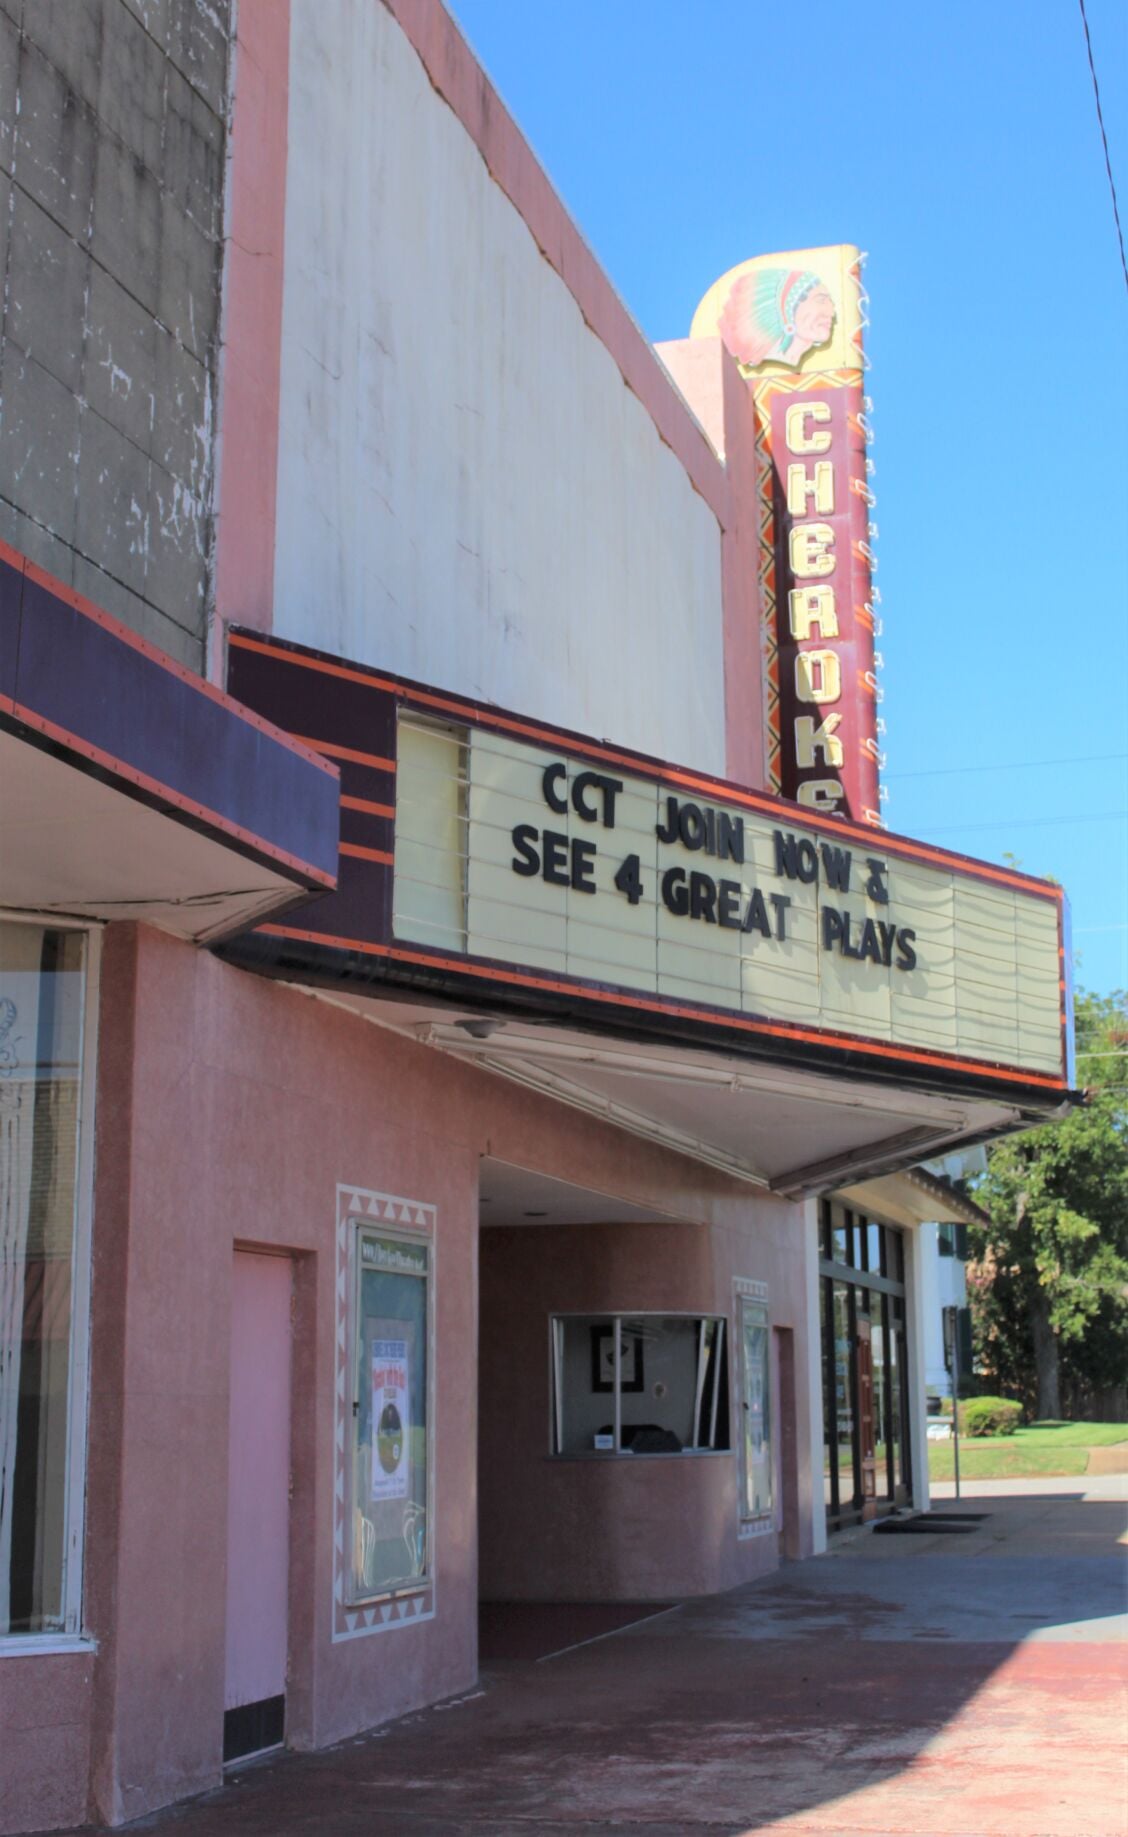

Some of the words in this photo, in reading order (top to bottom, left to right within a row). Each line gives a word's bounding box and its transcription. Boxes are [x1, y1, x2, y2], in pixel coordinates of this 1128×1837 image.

[512, 824, 598, 894] SEE
[614, 853, 643, 905] 4
[661, 866, 791, 941] GREAT
[822, 905, 917, 971] PLAYS
[542, 762, 623, 829] CCT
[656, 796, 745, 864] JOIN
[773, 829, 852, 893] NOW
[866, 857, 890, 905] &
